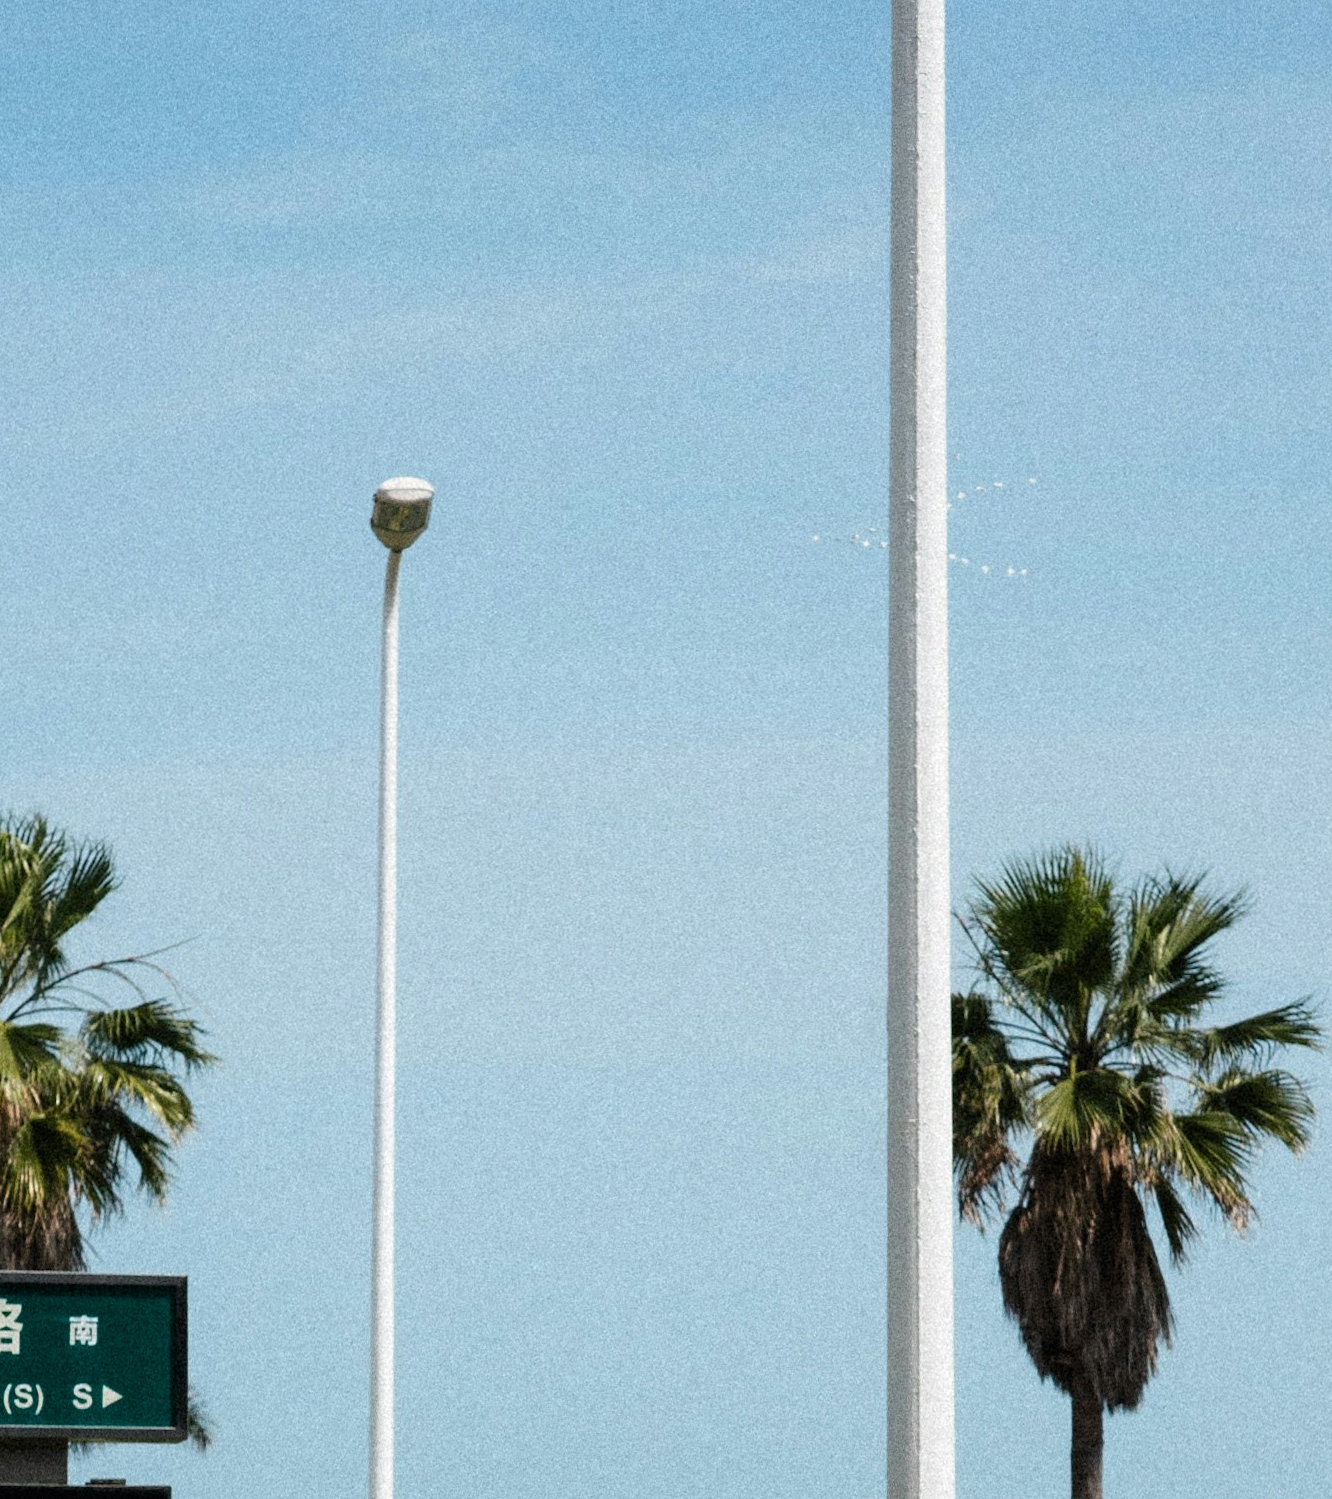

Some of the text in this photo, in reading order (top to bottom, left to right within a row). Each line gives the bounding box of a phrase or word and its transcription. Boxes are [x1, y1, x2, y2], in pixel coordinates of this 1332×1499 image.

[69, 1314, 99, 1346] 南
[3, 1382, 44, 1416] (S)
[72, 1382, 93, 1410] S
